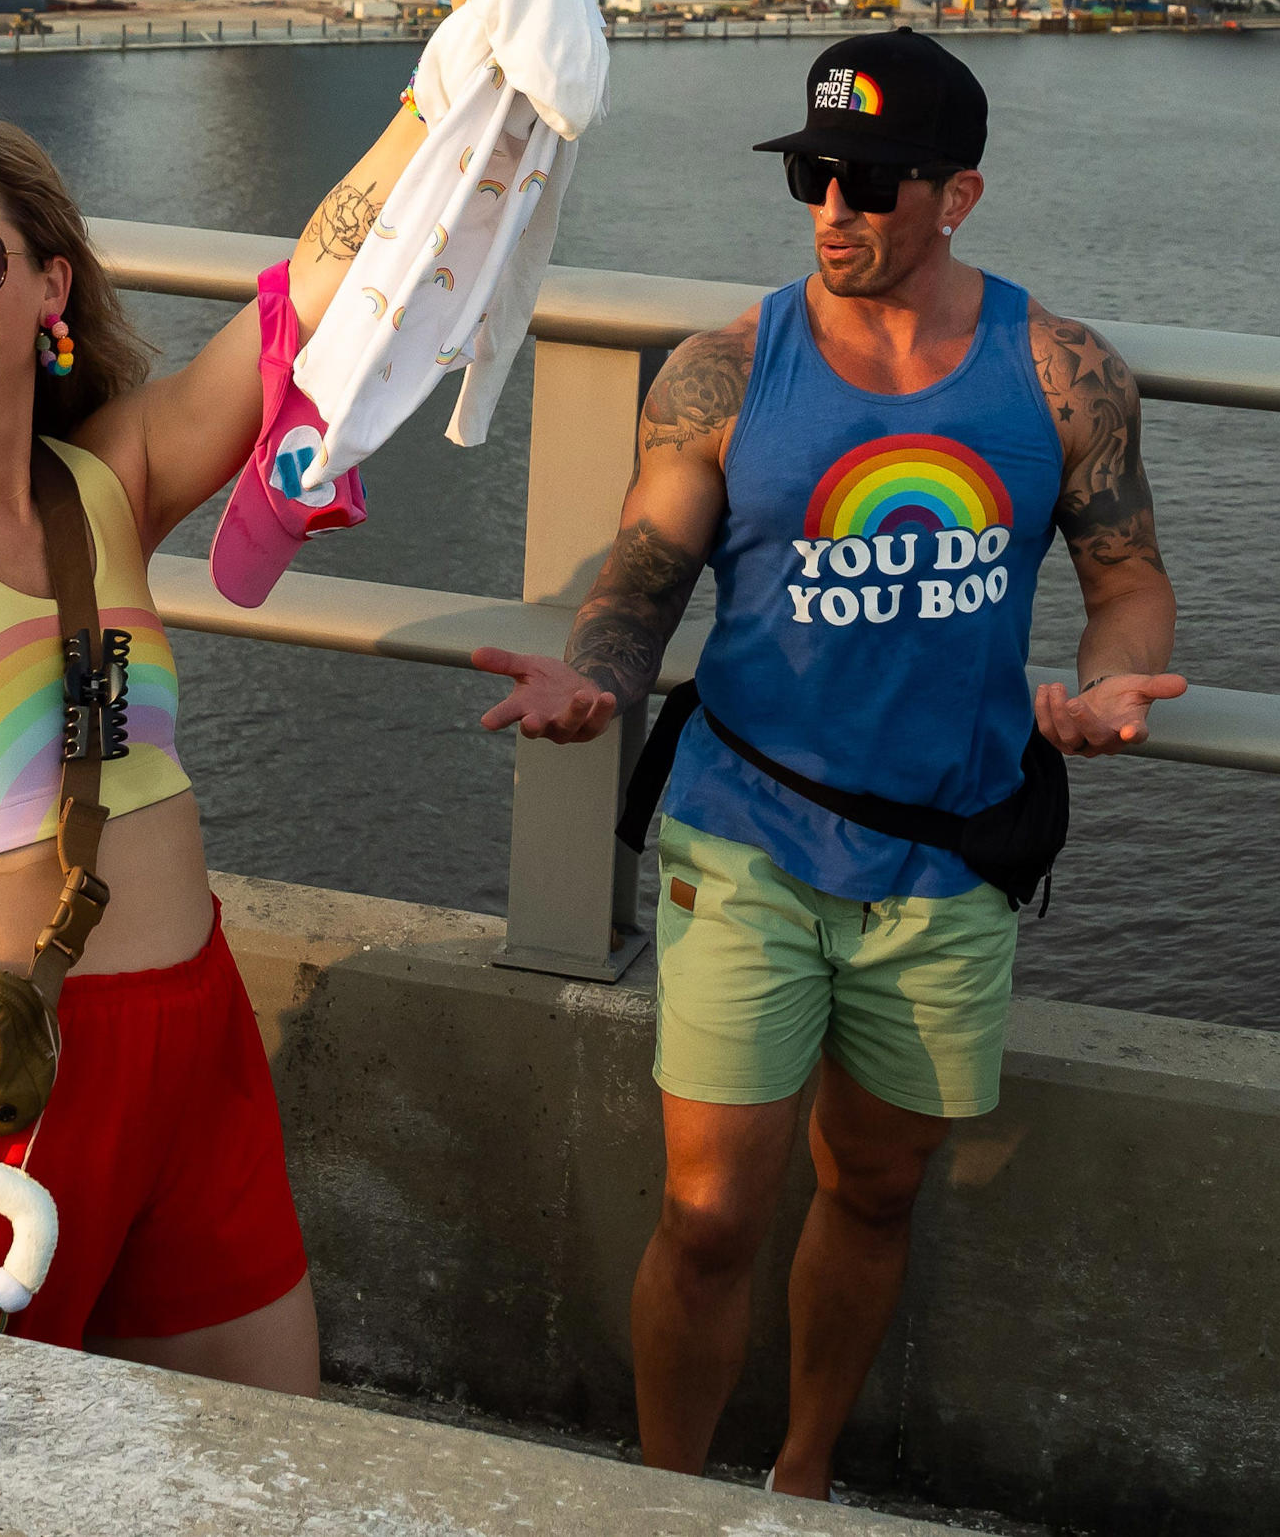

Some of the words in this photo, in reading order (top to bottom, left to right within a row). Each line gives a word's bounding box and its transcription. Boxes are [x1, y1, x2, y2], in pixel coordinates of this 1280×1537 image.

[829, 68, 854, 82] THE
[815, 81, 851, 96] PRIDE
[814, 95, 849, 109] FACE
[792, 533, 918, 579] YOU
[933, 527, 1010, 570] DO
[787, 584, 904, 626] YOU
[917, 566, 1008, 619] BOO
